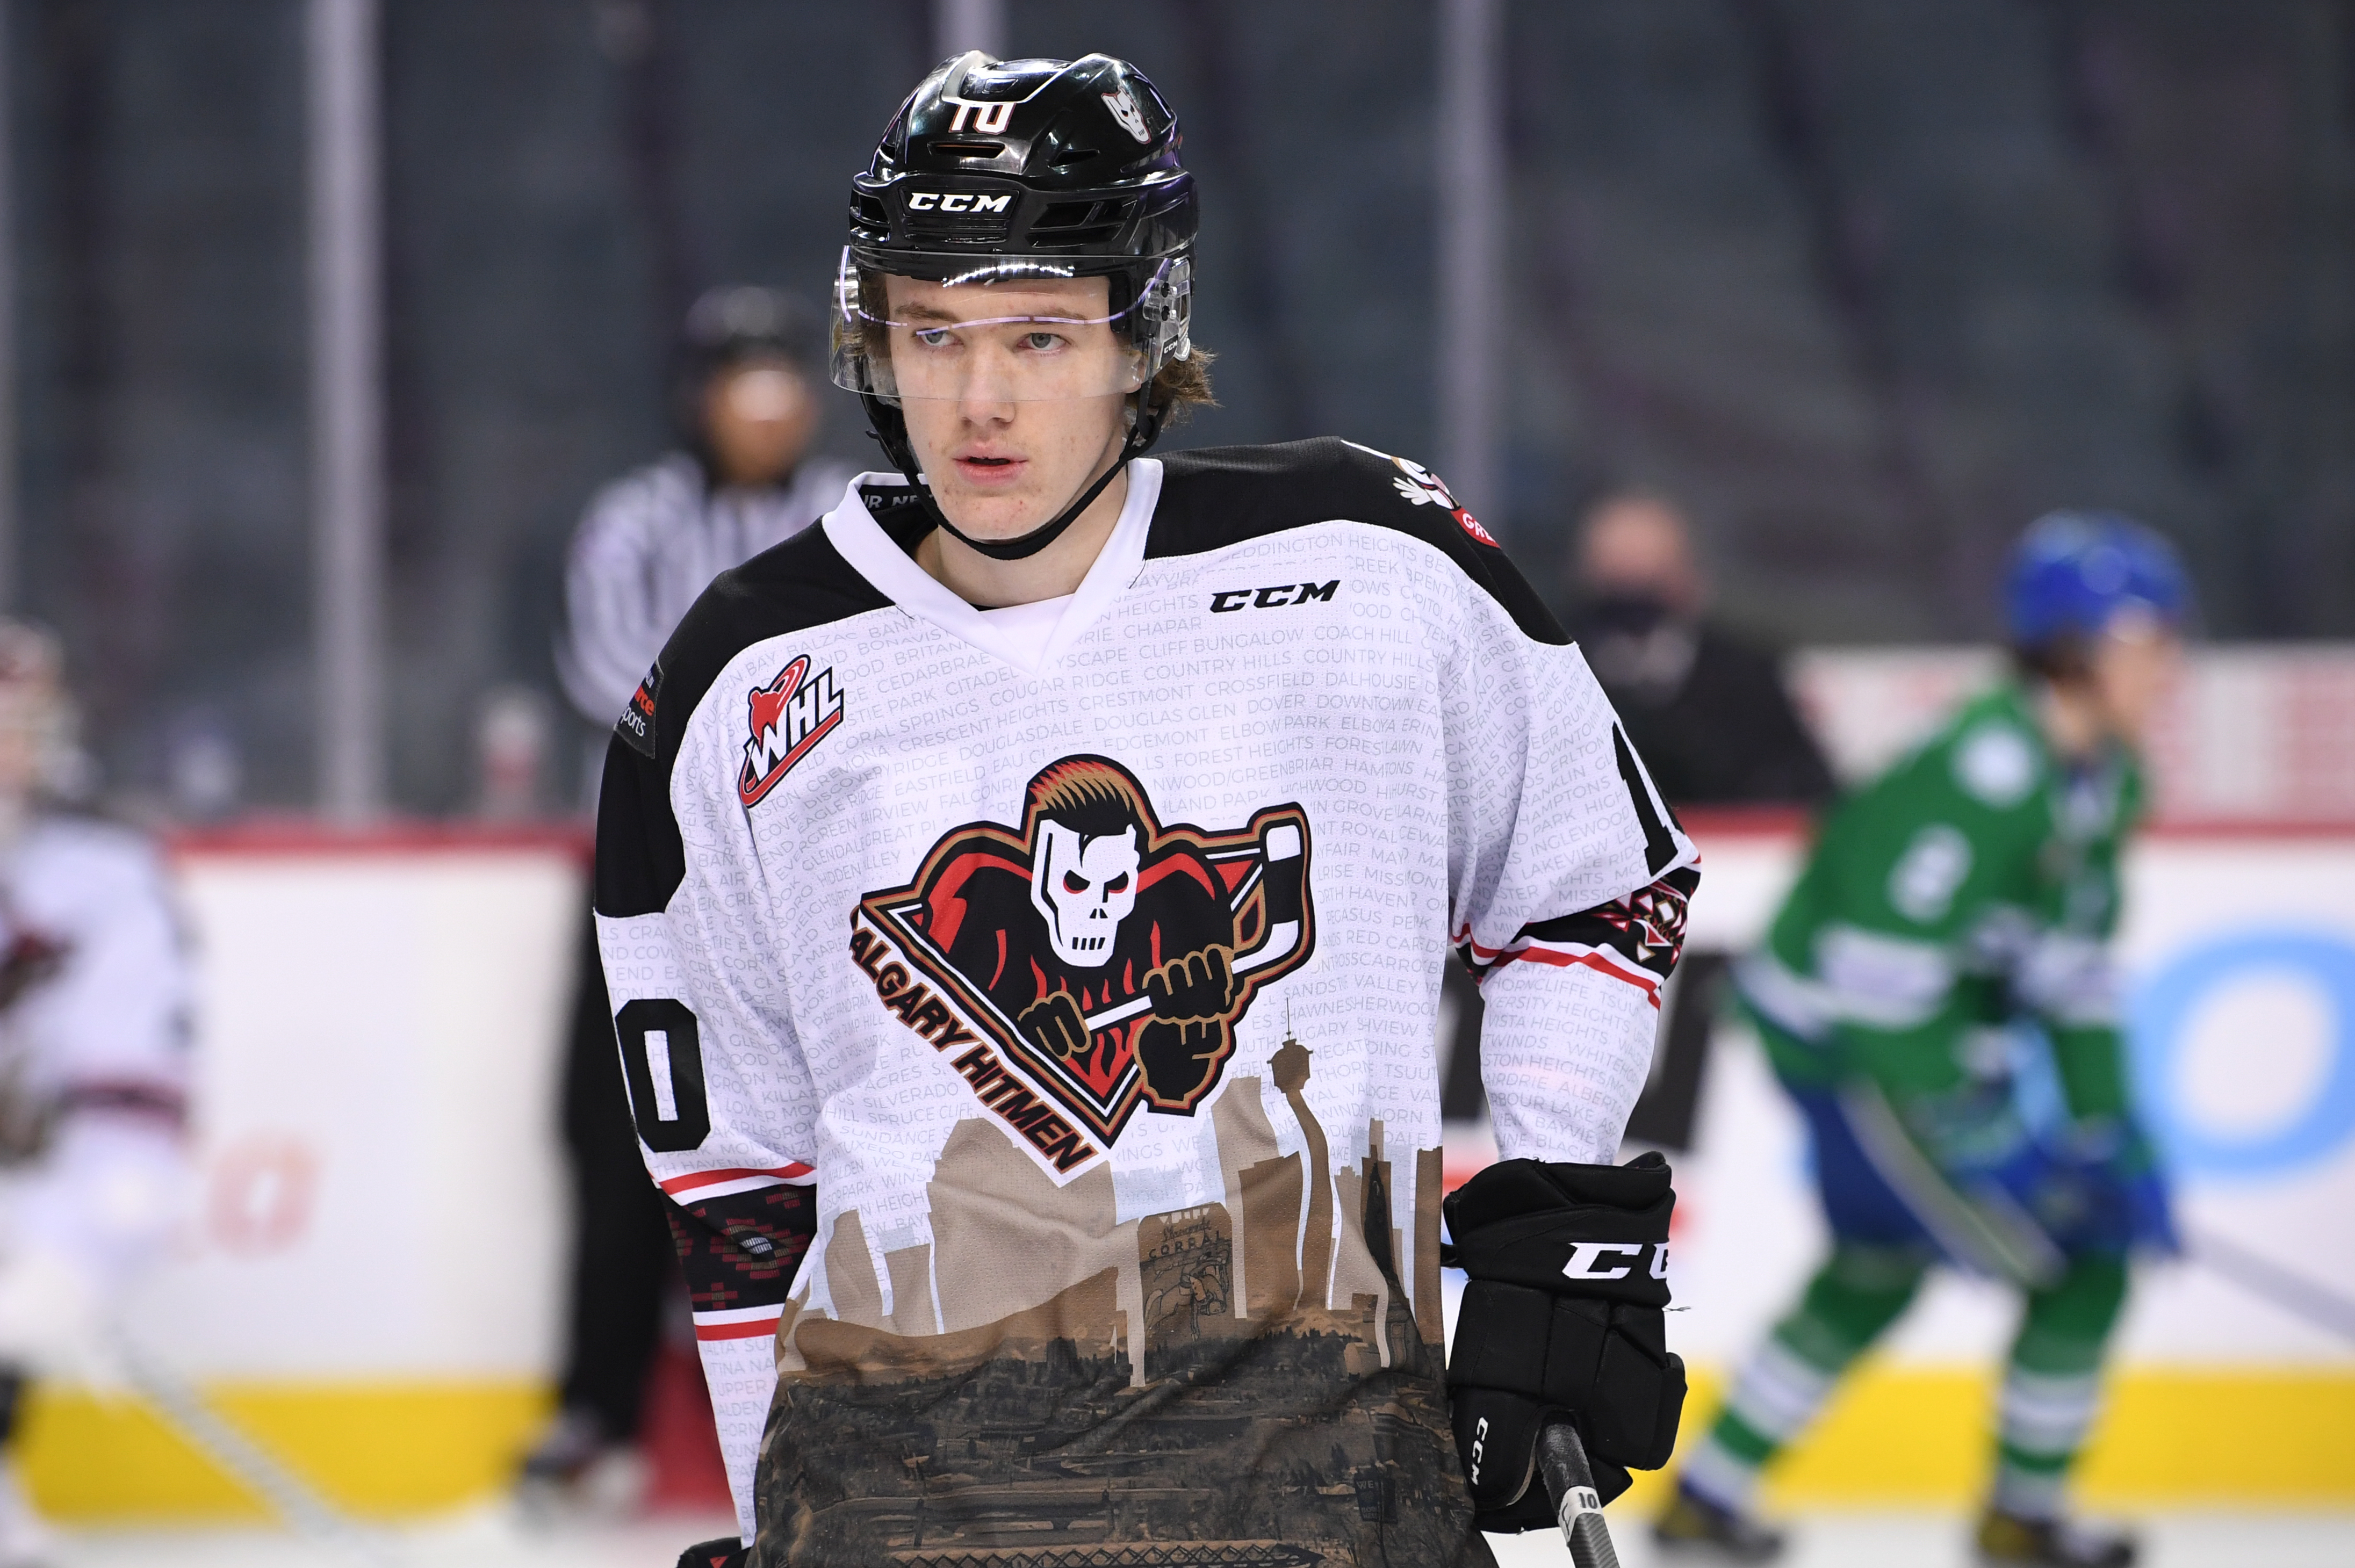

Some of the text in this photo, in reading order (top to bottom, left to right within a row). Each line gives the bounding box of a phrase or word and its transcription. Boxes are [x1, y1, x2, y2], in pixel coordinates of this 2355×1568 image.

[909, 192, 1012, 213] CCM
[1164, 340, 1178, 354] CCM
[1349, 534, 1417, 561] HEIGHTS
[1119, 595, 1199, 618] HEIGHTS
[1209, 580, 1341, 613] CCM
[894, 641, 967, 666] BRITAN
[1056, 625, 1412, 669] YSCAPE CLIFF BUNGALOW COACH HILL
[745, 652, 776, 677] BAY
[877, 652, 991, 693] CEDARBRAE
[989, 648, 1435, 707] COUGAR RIDGE COUNTRY HILLS COUNTRY HILLS
[888, 689, 938, 713] PARK
[946, 666, 1019, 696] CITADEL
[621, 706, 646, 737] ports
[744, 666, 844, 783] WHL
[834, 698, 980, 755] CORAL SPRINGS
[898, 671, 1416, 752] CRESCENT HEIGHTS CRESTMONT CROSSFIELD DALHOUSIE
[1530, 702, 1585, 749] EER RUN
[1221, 719, 1280, 740] ELBOW
[1284, 715, 1330, 729] PARK
[1341, 716, 1396, 733] ELBOYA
[1402, 718, 1439, 739] ERIN
[803, 764, 890, 810] DISCOVERY
[894, 752, 949, 776] RIDGE
[959, 719, 1084, 761] DOUGLASDALE
[1094, 709, 1183, 731] DOUGLAS
[1188, 703, 1236, 721] GLEN
[1248, 693, 1306, 714] DOVER
[1317, 694, 1414, 711] DOWNTOWN
[1175, 747, 1243, 767] FOREST
[1249, 735, 1314, 758] HEIGHTS
[1325, 736, 1384, 757] FORES
[1551, 735, 1604, 774] ERLTON
[807, 745, 890, 792] CREMONA
[1155, 757, 1334, 791] NWOOD/GREENBRIAR
[797, 799, 845, 834] EAGLE
[894, 765, 986, 797] EASTFIELD
[993, 753, 1024, 774] EAU
[1518, 776, 1611, 825] HAMPTONS
[1521, 765, 1587, 806] RANKLIN
[1611, 720, 1679, 877] 1
[758, 811, 801, 842] COVE
[1333, 800, 1394, 822] GROVE
[1533, 808, 1576, 837] PARK
[774, 816, 858, 880] EVERGREEN
[861, 799, 930, 826] FAIRVIEW
[939, 778, 1017, 809] FALCONRI
[1341, 821, 1397, 843] ROYAL
[1531, 805, 1629, 859] INGLEWOOD
[802, 837, 865, 871] GLENDALE
[865, 824, 914, 847] GREAT
[1319, 842, 1360, 859] YFAIR
[1522, 838, 1609, 880] LAKEVIEW
[1349, 886, 1408, 908] HAVEN
[1559, 883, 1632, 902] MISSION
[1346, 930, 1380, 945] RED
[796, 966, 829, 1002] LAKE
[1354, 974, 1418, 994] VALLEY
[1493, 978, 1589, 1000] HORNCLIFFE
[863, 1013, 885, 1029] HILL
[1531, 1016, 1608, 1045] HEIGHTS
[1557, 1001, 1630, 1034] HEIGHTS
[849, 927, 1099, 1175] ALGARY HITMEN
[615, 999, 711, 1154] 0
[865, 1066, 921, 1091] ACRES
[863, 1082, 959, 1109] SILVERADO
[1558, 1081, 1617, 1114] ALBERT
[824, 1105, 860, 1123] HILL
[867, 1107, 935, 1126] SPRUCE
[1551, 1099, 1595, 1124] LAKE
[839, 1126, 936, 1145] SUNDANCE
[1535, 1115, 1596, 1146] BAYVIE
[839, 1138, 905, 1159] TUXEDO
[881, 1173, 926, 1190] WINS
[877, 1190, 924, 1213] HEIGH
[1471, 1417, 1488, 1486] CCM
[1579, 1492, 1598, 1509] 10
